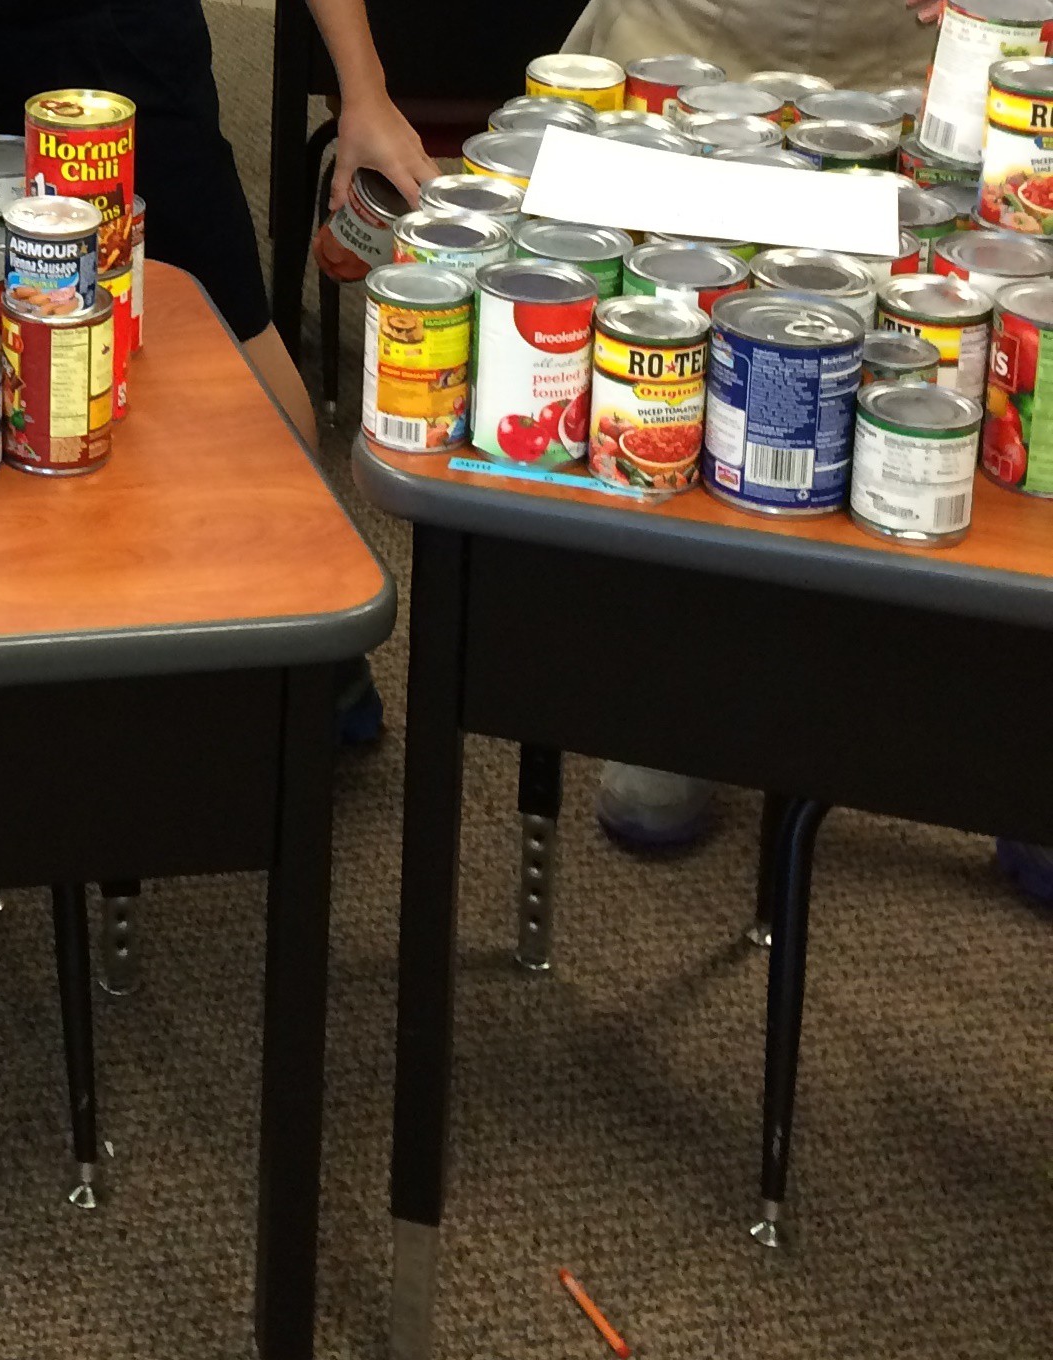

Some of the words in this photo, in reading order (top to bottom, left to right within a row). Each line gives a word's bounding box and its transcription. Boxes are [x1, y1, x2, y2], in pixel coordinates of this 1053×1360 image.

[1031, 104, 1053, 128] R
[39, 128, 133, 160] Hormel
[60, 159, 119, 181] Chili
[10, 236, 77, 258] ARMOUR
[37, 259, 78, 277] Sausage
[533, 368, 580, 387] peeled
[640, 382, 703, 398] Original
[637, 407, 664, 416] DICED
